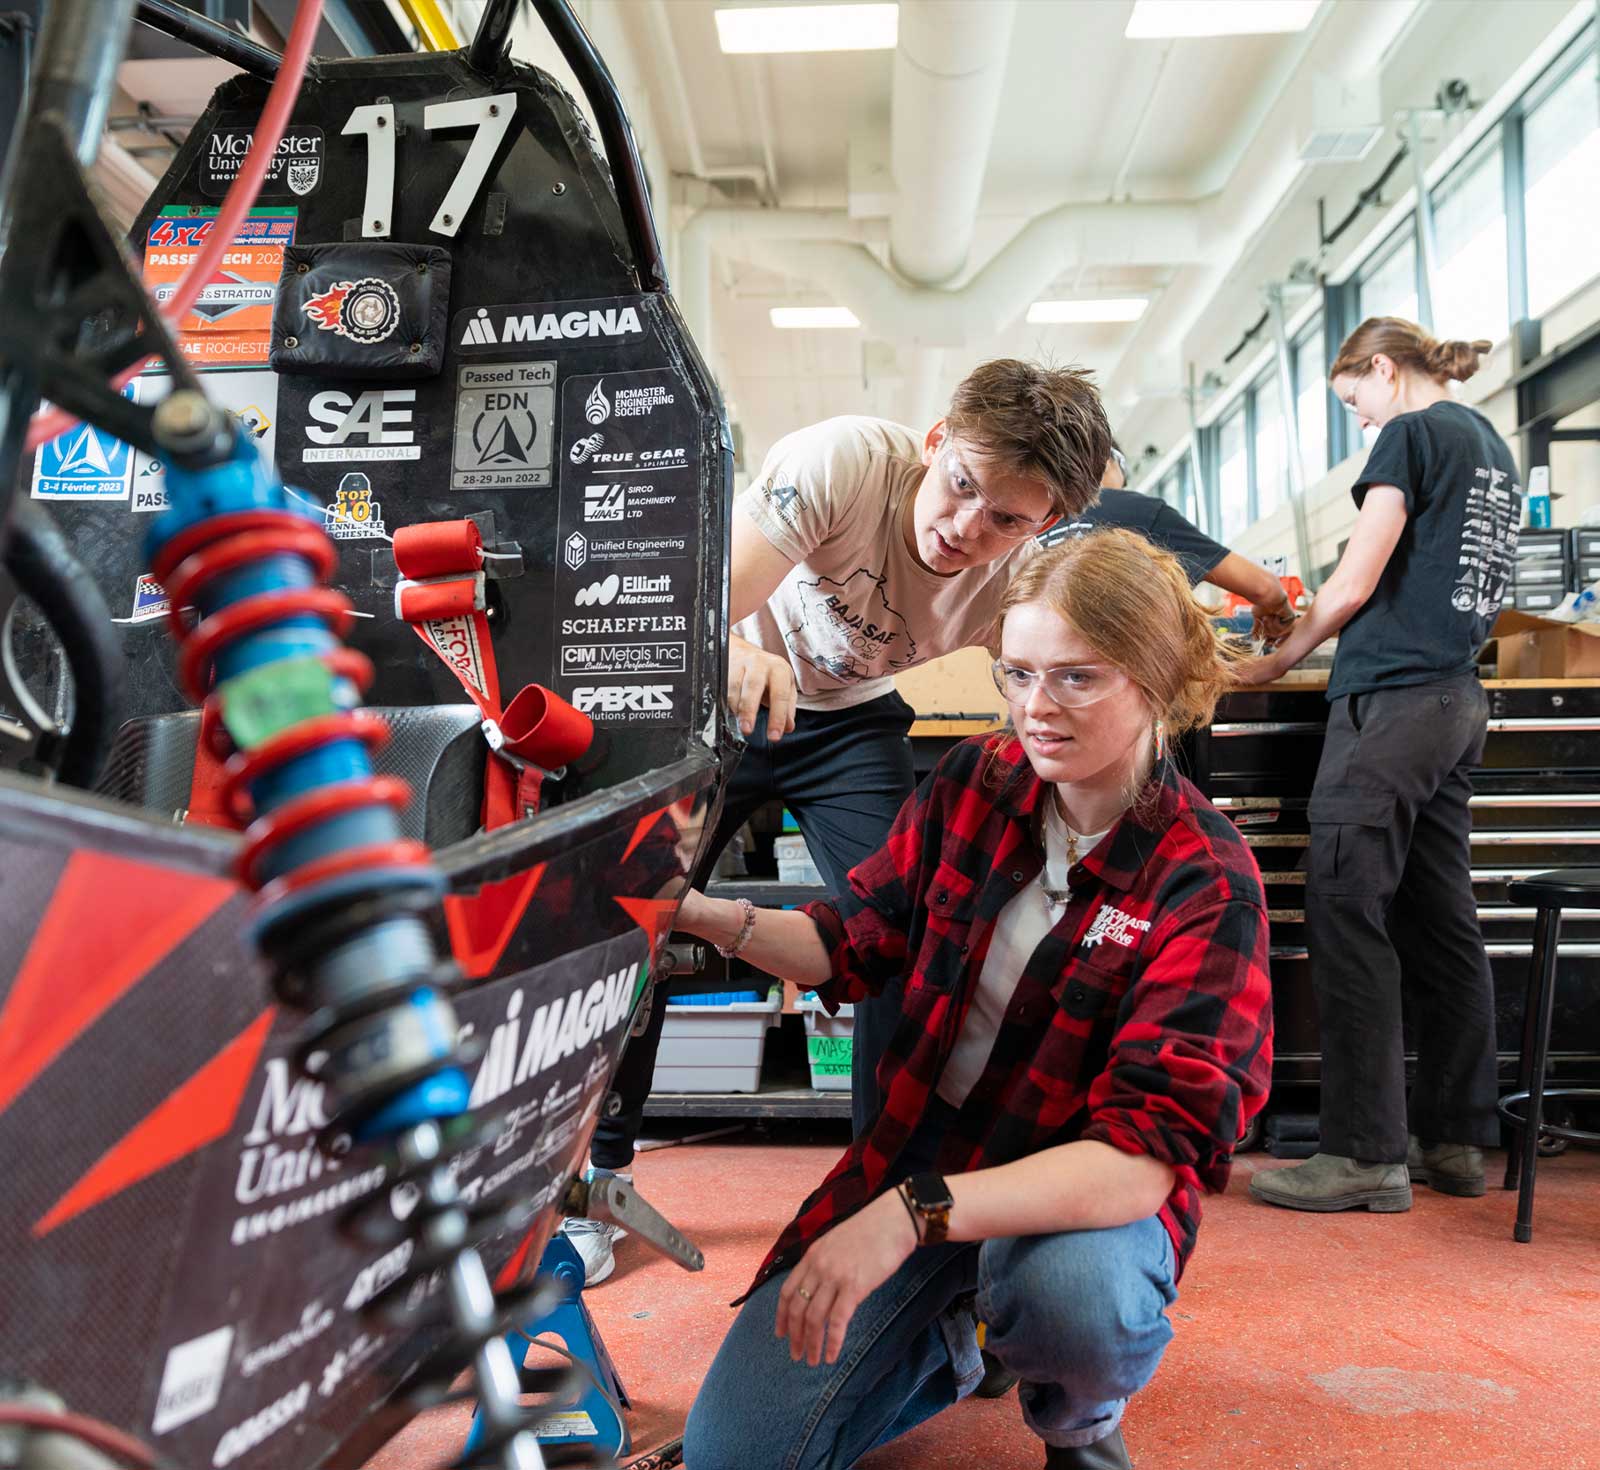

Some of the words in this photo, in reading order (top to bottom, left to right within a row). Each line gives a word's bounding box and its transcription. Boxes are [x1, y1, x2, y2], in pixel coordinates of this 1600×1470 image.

[209, 134, 322, 155] Mcster
[209, 156, 287, 172] Univity
[341, 92, 517, 237] 17
[149, 253, 200, 265] PASSE
[221, 253, 253, 265] ECH
[157, 289, 273, 300] BRS&STRATTON
[502, 306, 643, 343] MAGNA
[205, 342, 270, 354] ROCHESTE
[465, 369, 514, 383] Passed
[519, 367, 551, 381] Tech
[615, 386, 666, 400] MCMASTER
[484, 392, 529, 411] EDN
[615, 394, 675, 408] ENGINEERING
[305, 389, 416, 444] SAE
[614, 405, 653, 417] SOCIETY
[305, 448, 412, 460] INTERNATIONAL
[592, 452, 634, 463] TRUE
[640, 448, 686, 460] GEAR
[643, 460, 669, 468] SPLINE
[463, 475, 493, 484] 28-29
[495, 475, 513, 484] Jan
[515, 473, 541, 483] 2022
[43, 481, 60, 491] 3-4
[61, 482, 97, 492] Février
[97, 481, 121, 491] 2023
[627, 485, 654, 494] SIRCO
[136, 492, 171, 507] PASS
[338, 489, 370, 501] TOP
[627, 496, 676, 506] MACHINERY
[335, 500, 371, 523] 10
[590, 509, 620, 519] HAAS
[626, 510, 643, 518] LTD
[322, 521, 384, 531] TENNESEE
[327, 530, 384, 539] OCHESTE
[591, 541, 625, 551] Unified
[627, 538, 685, 551] Engineering
[622, 575, 671, 593] Elliott
[616, 594, 675, 605] Matsuura
[562, 615, 687, 635] SCHAEFFLER
[825, 595, 864, 630] BAJA
[862, 624, 897, 644] SAE
[564, 648, 596, 662] CIM
[600, 646, 652, 661] Metals
[655, 645, 682, 660] Inc.
[584, 662, 613, 671] Cutting
[623, 660, 660, 671] Perfection
[572, 684, 674, 712] FABRIS
[586, 711, 626, 720] olutions
[628, 710, 673, 722] provider.
[514, 962, 639, 1087] MAGNA
